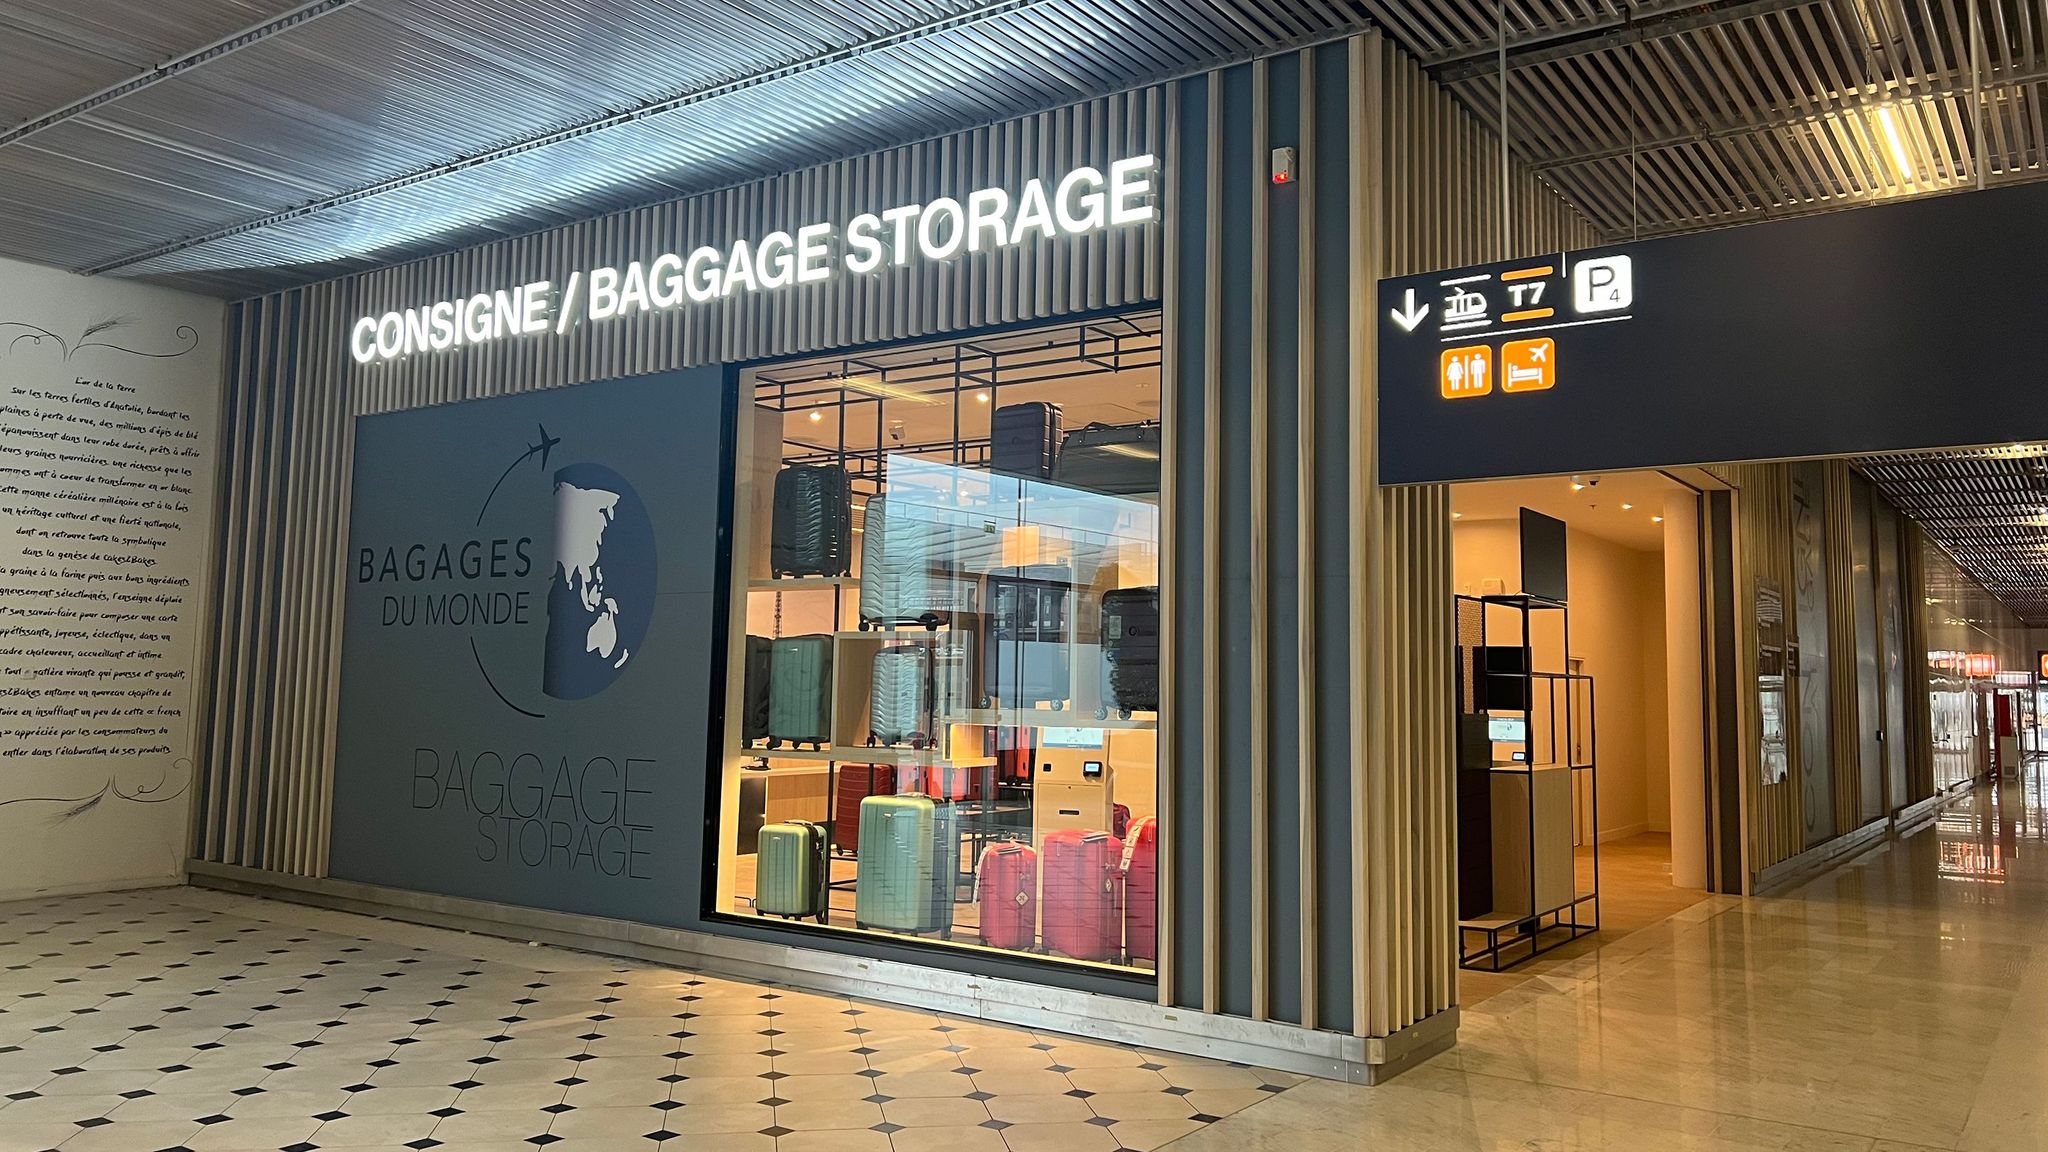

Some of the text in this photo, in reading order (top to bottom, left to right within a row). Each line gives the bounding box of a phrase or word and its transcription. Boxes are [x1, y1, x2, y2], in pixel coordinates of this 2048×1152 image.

[352, 280, 550, 363] CONSIGNE
[588, 222, 831, 321] BAGGAGE
[844, 153, 1154, 273] STORAGE
[1507, 281, 1546, 307] T7
[93, 379, 104, 389] de
[105, 381, 114, 391] la
[116, 383, 136, 394] terre
[28, 388, 42, 399] les
[44, 391, 69, 404] terres
[71, 392, 101, 408] fertiles
[146, 406, 178, 420] bordant
[179, 412, 191, 422] les
[0, 405, 31, 417] plaines
[33, 407, 40, 418] à
[40, 412, 64, 422] perte
[66, 414, 77, 423] de
[79, 417, 96, 428] vue,
[98, 418, 114, 429] des
[148, 425, 172, 439] d'épis
[173, 429, 184, 438] de
[185, 430, 199, 440] blé
[60, 432, 81, 444] dans
[83, 435, 101, 445] leur
[102, 438, 120, 448] robe
[122, 441, 147, 454] dorée,
[148, 445, 171, 456] prêts
[172, 446, 179, 456] à
[180, 447, 200, 458] offrir
[0, 444, 22, 456] leurs
[24, 448, 57, 461] graines
[112, 460, 128, 469] une
[129, 460, 162, 473] richesse
[163, 467, 179, 477] que
[181, 467, 193, 477] les
[33, 469, 51, 480] ont
[50, 469, 57, 479] à
[84, 474, 96, 483] de
[97, 475, 146, 489] transformer
[148, 483, 158, 492] en
[21, 489, 51, 500] manne
[53, 489, 97, 503] céréalière
[98, 495, 139, 507] millénaire
[141, 500, 156, 510] est
[156, 500, 163, 510] à
[164, 502, 173, 511] la
[1, 505, 182, 532] un héritage culturel et une fierté nationale,
[15, 526, 167, 550] dont on retrouve toute la symbolique
[21, 546, 44, 558] dans
[46, 549, 55, 558] la
[57, 550, 88, 561] genèse
[90, 552, 101, 561] de
[358, 537, 533, 583] BAGAGES
[9, 566, 38, 578] graine
[40, 567, 47, 577] à
[49, 568, 58, 578] la
[61, 566, 86, 581] farine
[87, 571, 106, 583] puis
[125, 572, 145, 585] bons
[146, 574, 190, 587] ingrédients
[55, 587, 110, 602] sélectionnés,
[112, 591, 153, 604] l'enseigne
[154, 593, 183, 607] déploie
[8, 607, 26, 617] son
[25, 606, 77, 618] savoir-faire
[78, 612, 99, 622] pour
[100, 613, 140, 623] composer
[140, 615, 156, 623] une
[157, 614, 178, 623] carte
[382, 591, 531, 626] DU MONDE
[53, 628, 89, 640] joyeuse,
[92, 628, 137, 644] éclectique,
[139, 631, 159, 642] dans
[160, 634, 171, 642] un
[25, 648, 75, 659] chaleureux,
[77, 648, 126, 660] accueillant
[125, 650, 137, 658] et
[65, 667, 96, 679] vivante
[97, 668, 113, 681] qui
[112, 671, 142, 681] pousse
[143, 669, 155, 678] et
[155, 669, 186, 680] grandit,
[43, 687, 76, 698] entame
[78, 690, 89, 698] un
[91, 690, 126, 698] nouveau
[127, 687, 160, 700] chapitre
[161, 688, 172, 697] de
[20, 709, 33, 718] en
[35, 704, 80, 718] insufflant
[80, 709, 91, 718] un
[92, 709, 109, 720] peu
[111, 707, 122, 716] de
[123, 707, 144, 716] cette
[157, 705, 181, 717] french
[14, 725, 59, 740] appréciée
[60, 729, 77, 740] par
[77, 727, 91, 737] les
[92, 726, 156, 737] consommateurs
[158, 726, 169, 734] du
[2, 747, 29, 759] entier
[31, 747, 53, 758] dans
[55, 745, 107, 756] l'élaboration
[109, 746, 120, 755] de
[120, 748, 137, 756] ses
[412, 747, 656, 829] BAGGAGE
[475, 815, 654, 880] STORAGE
